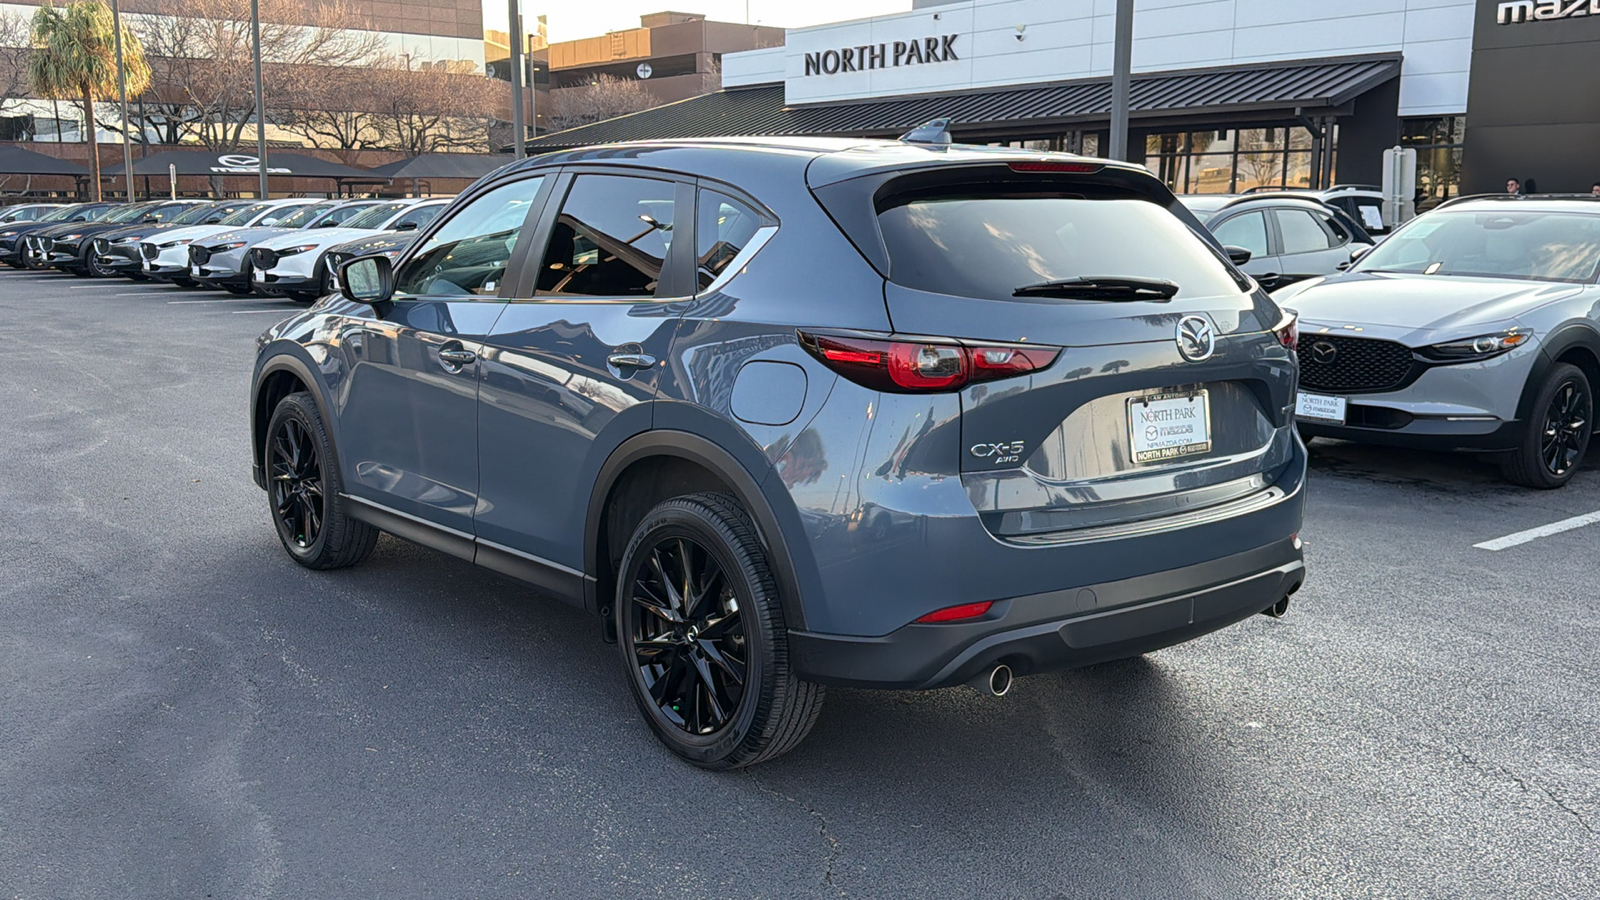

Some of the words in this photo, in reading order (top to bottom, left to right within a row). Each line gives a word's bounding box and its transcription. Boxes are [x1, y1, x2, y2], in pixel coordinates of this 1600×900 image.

[1497, 0, 1600, 24] maz
[804, 43, 886, 76] NORTH
[892, 34, 959, 67] PARK
[1140, 409, 1173, 423] NORTH
[1174, 406, 1196, 420] PARK
[1160, 424, 1193, 437] mazda
[970, 440, 1025, 457] CX-5
[1137, 450, 1161, 461] NORTH
[1161, 447, 1180, 458] PARK
[995, 455, 1019, 464] AWD
